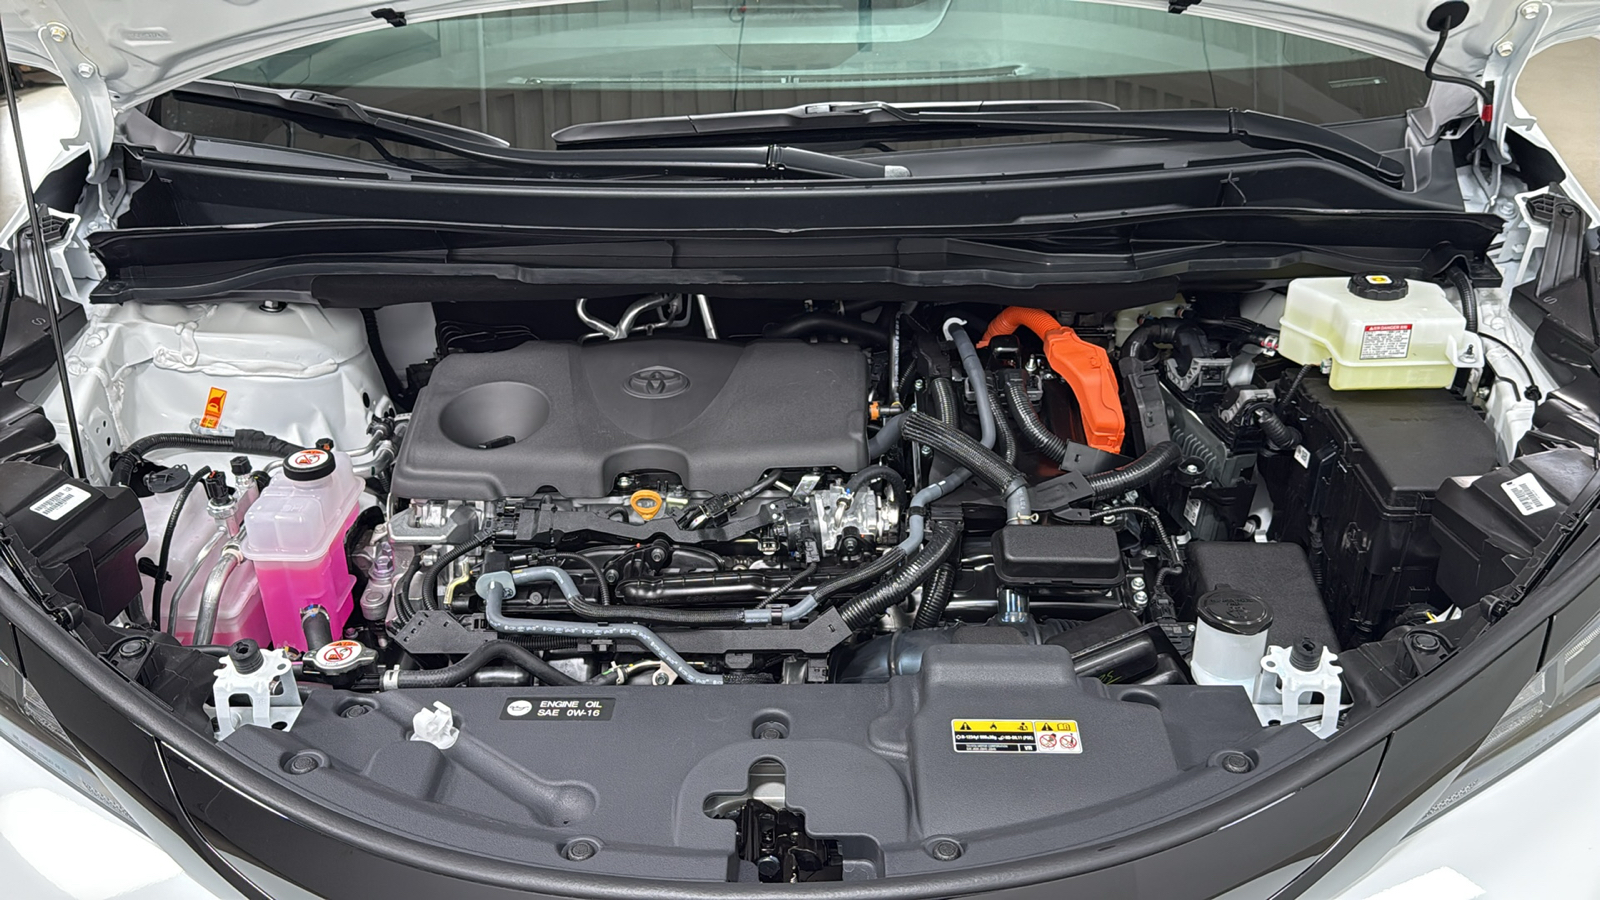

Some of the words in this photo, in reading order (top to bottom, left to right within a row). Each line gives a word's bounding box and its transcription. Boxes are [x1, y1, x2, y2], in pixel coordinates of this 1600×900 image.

[539, 700, 579, 708] ENGINE
[537, 709, 560, 717] SAE
[566, 709, 600, 717] 0W-16
